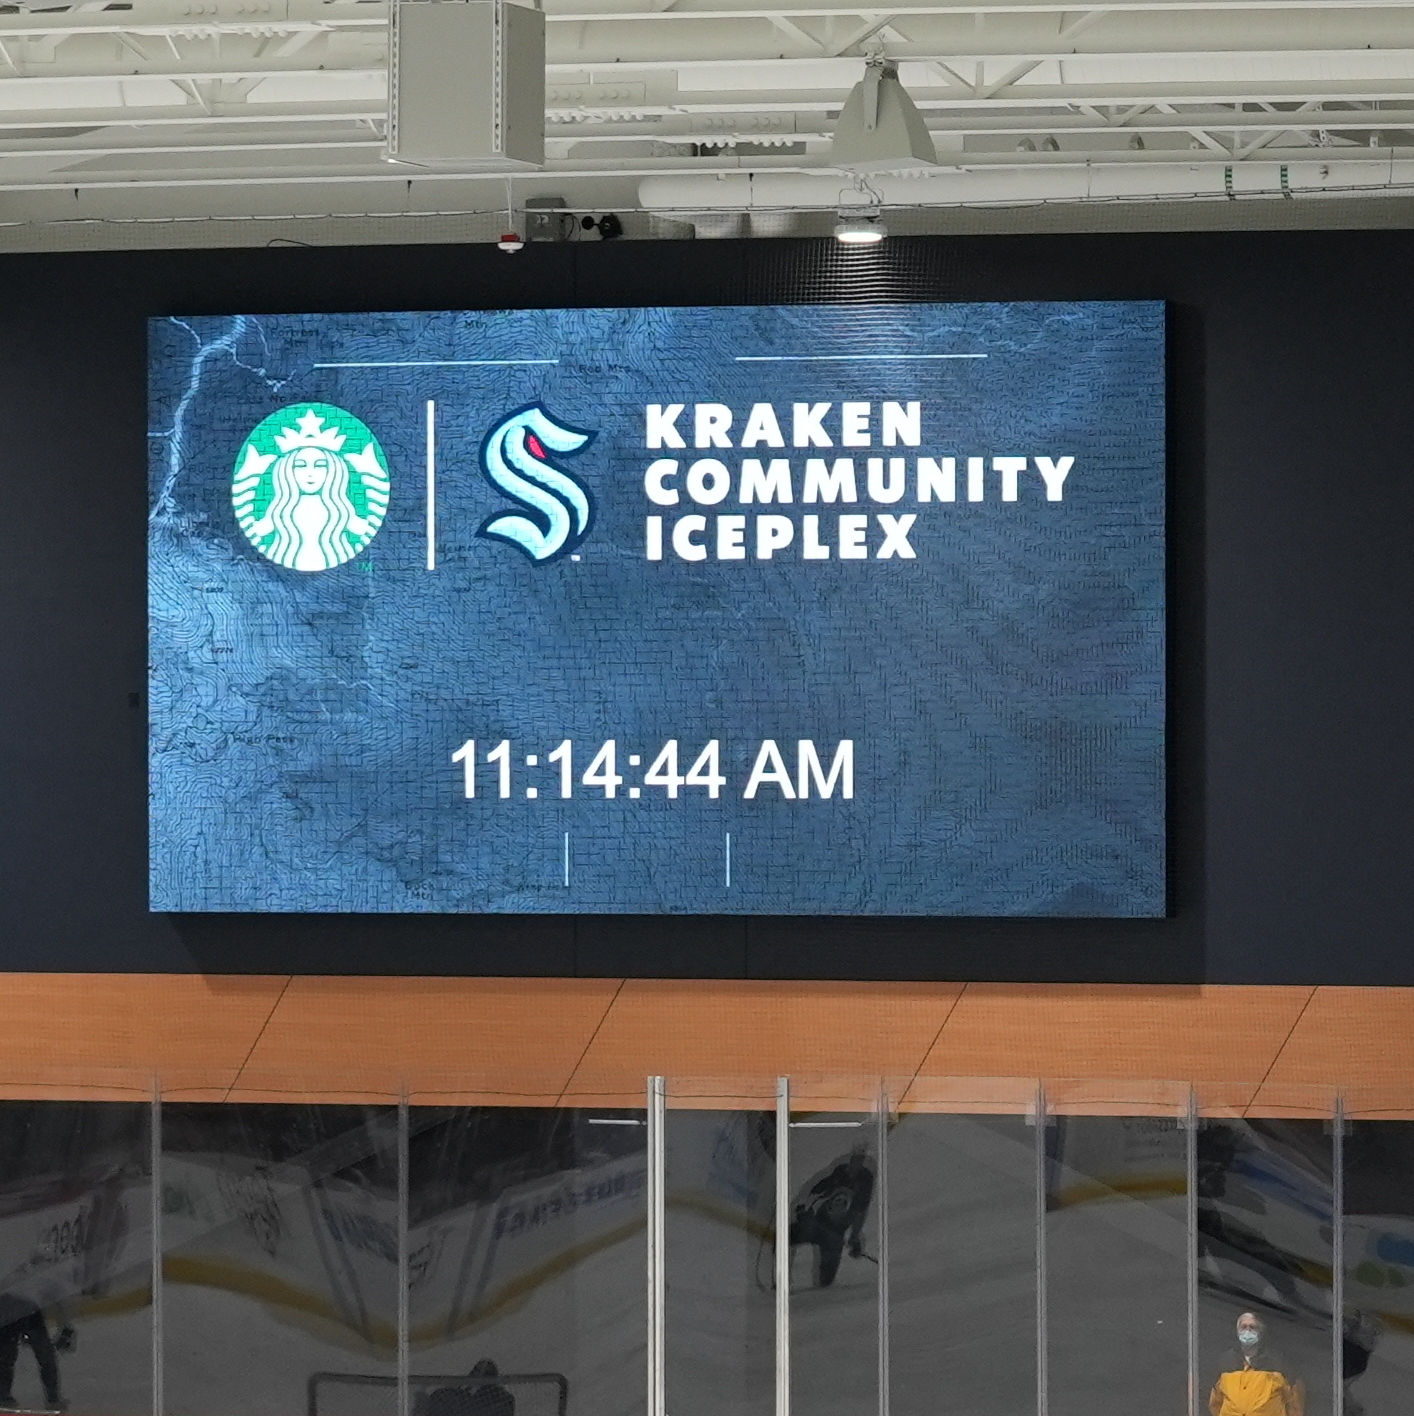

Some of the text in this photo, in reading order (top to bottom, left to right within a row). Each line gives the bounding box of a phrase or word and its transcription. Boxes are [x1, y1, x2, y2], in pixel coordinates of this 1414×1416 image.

[645, 401, 921, 449] KRAKEN
[644, 456, 1075, 506] COMMUNITY
[646, 513, 918, 562] ICEPLEX
[451, 739, 855, 799] 11:14:44 AM
